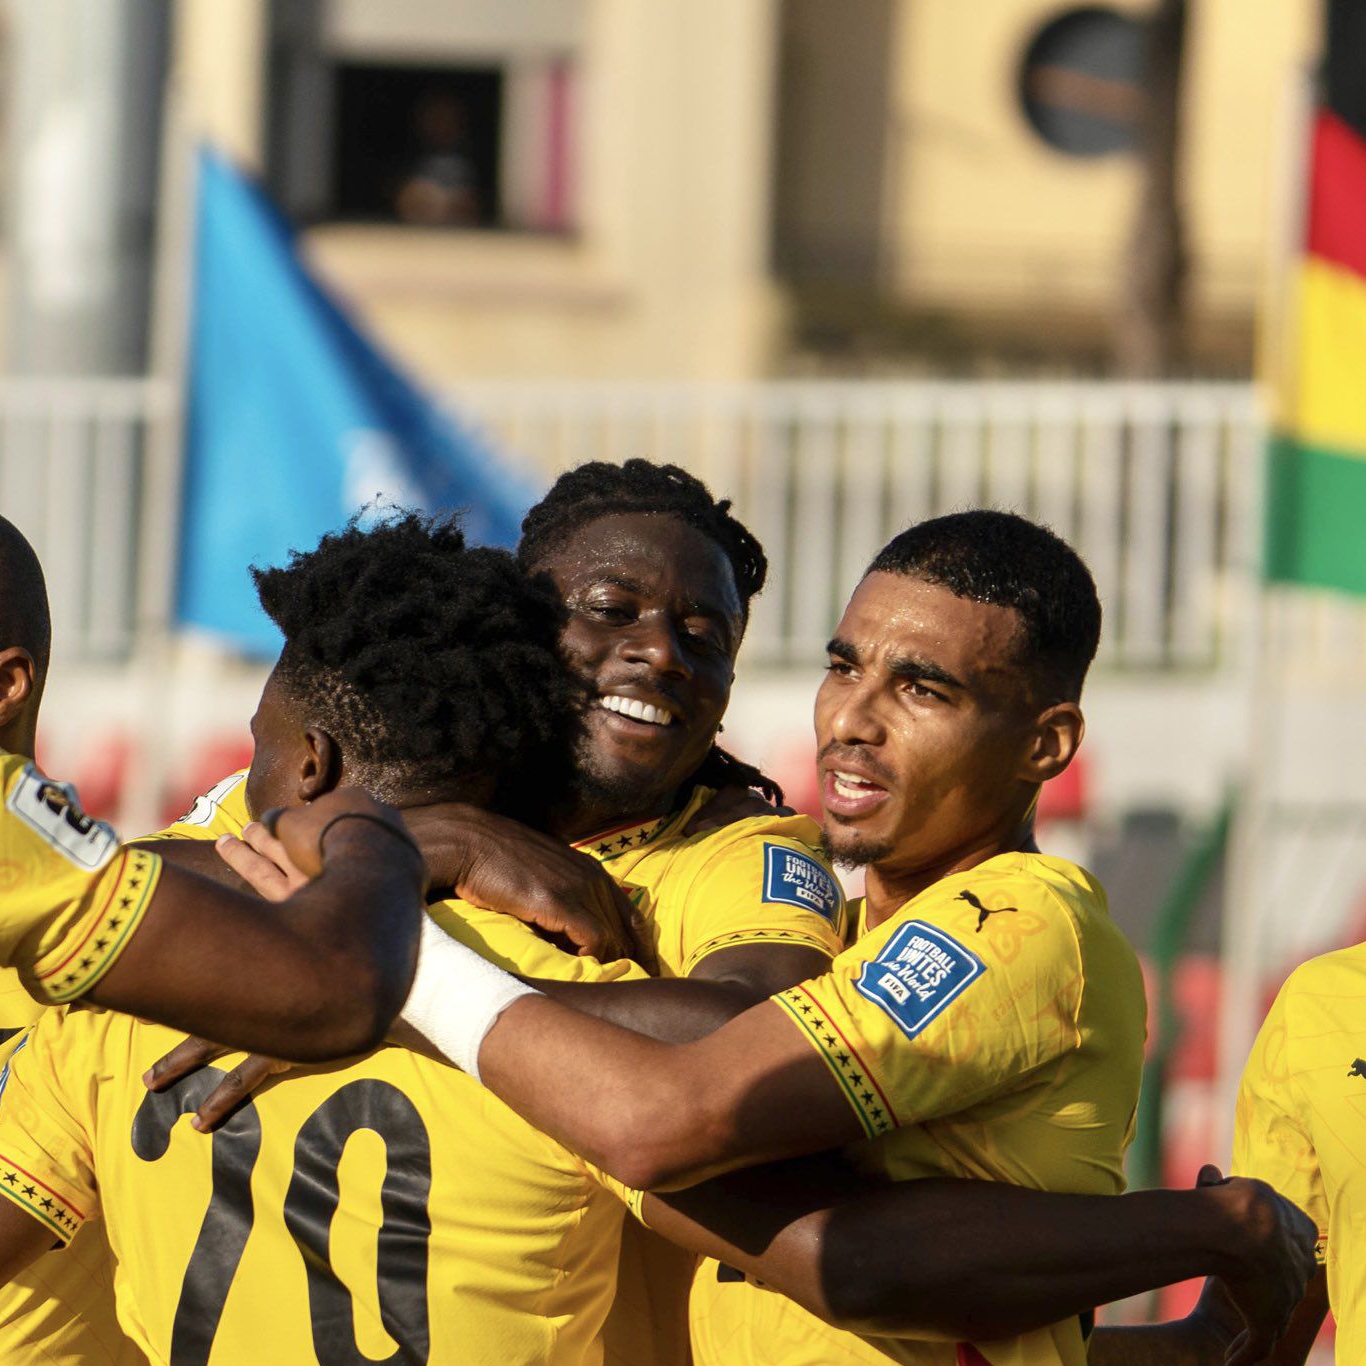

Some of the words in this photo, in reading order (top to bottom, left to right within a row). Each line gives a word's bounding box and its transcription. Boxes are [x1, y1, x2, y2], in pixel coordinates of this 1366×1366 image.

[895, 946, 948, 987] UNITES
[907, 935, 956, 975] FOOTBALL
[884, 977, 905, 999] FIFA
[896, 964, 937, 1002] World
